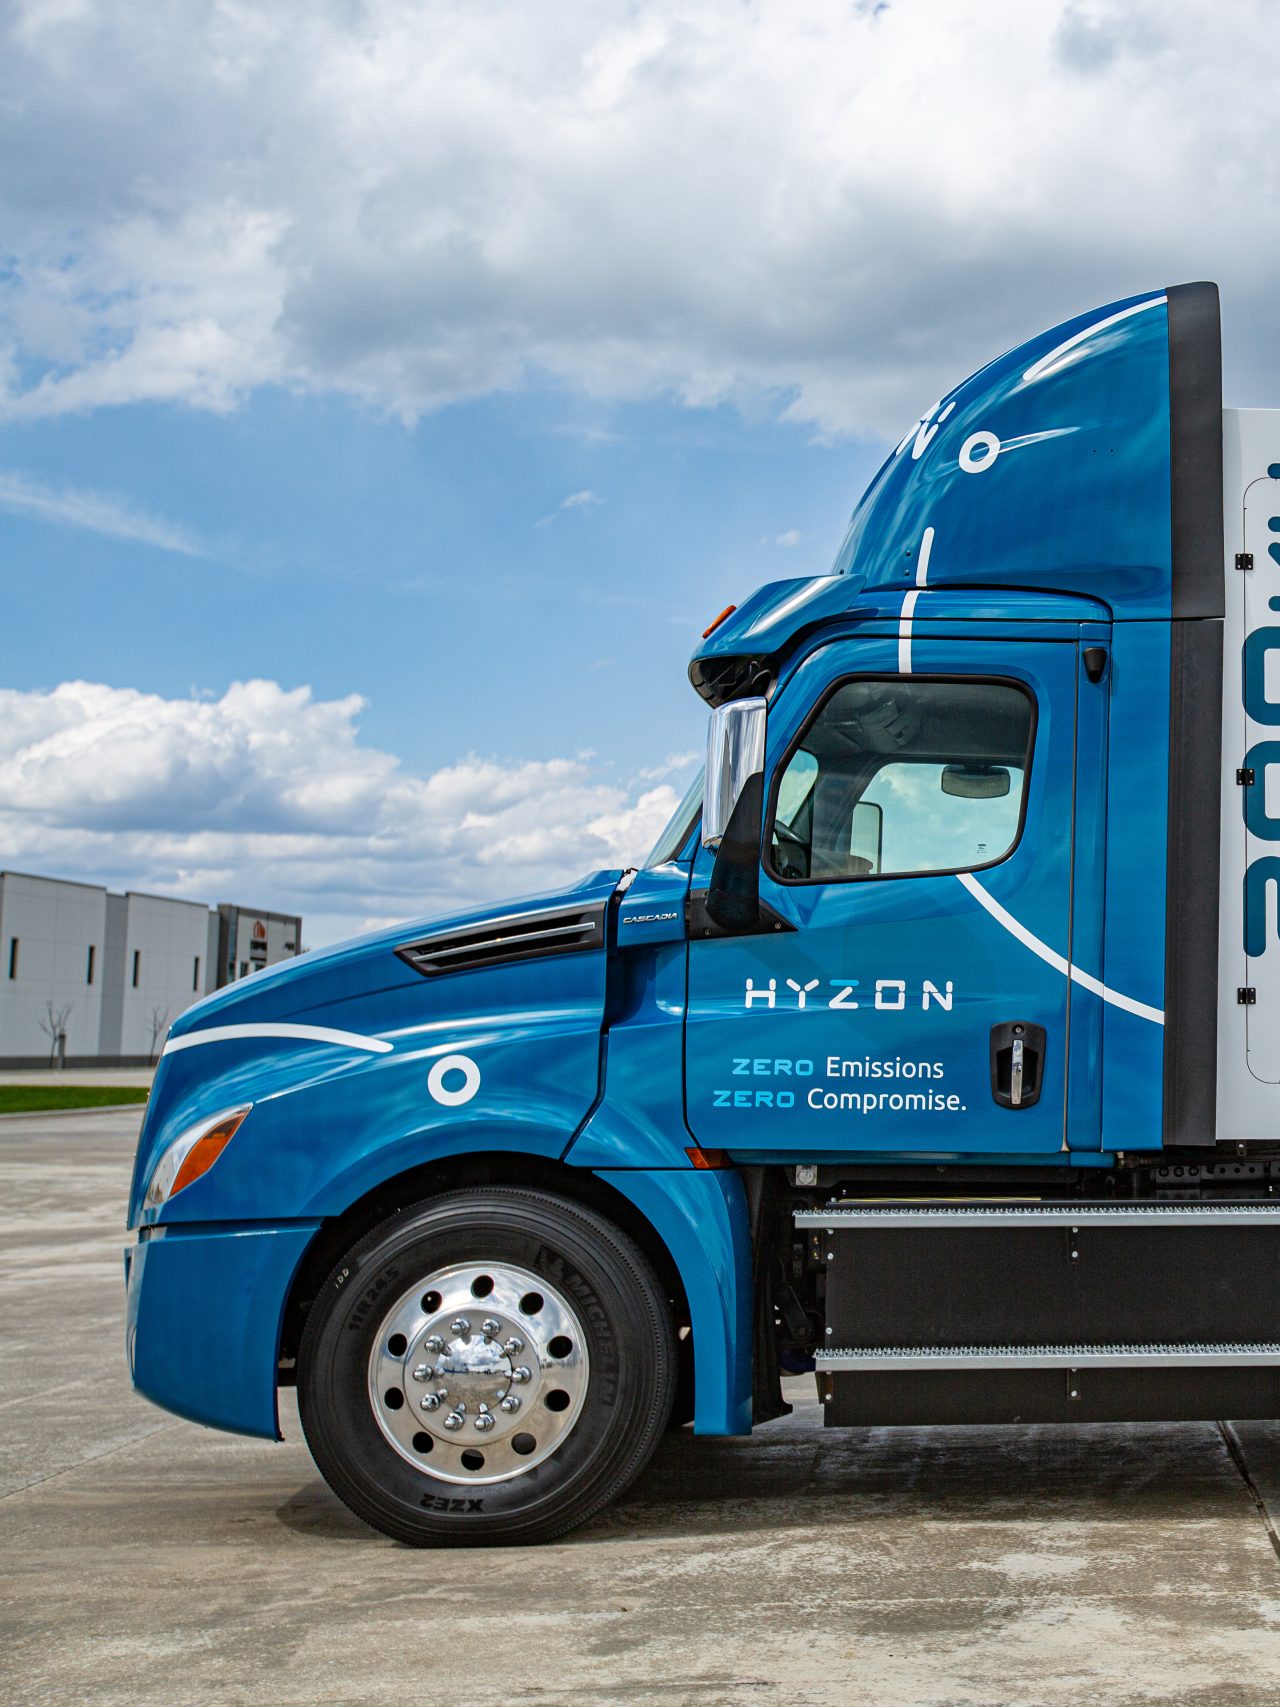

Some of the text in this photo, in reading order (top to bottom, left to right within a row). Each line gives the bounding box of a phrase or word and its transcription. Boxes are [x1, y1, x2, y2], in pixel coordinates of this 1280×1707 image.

[623, 912, 678, 924] CASCADIA
[745, 978, 953, 1011] HYZON
[732, 1056, 944, 1079] ZERO Emissions
[713, 1088, 967, 1114] ZERO Compromise.
